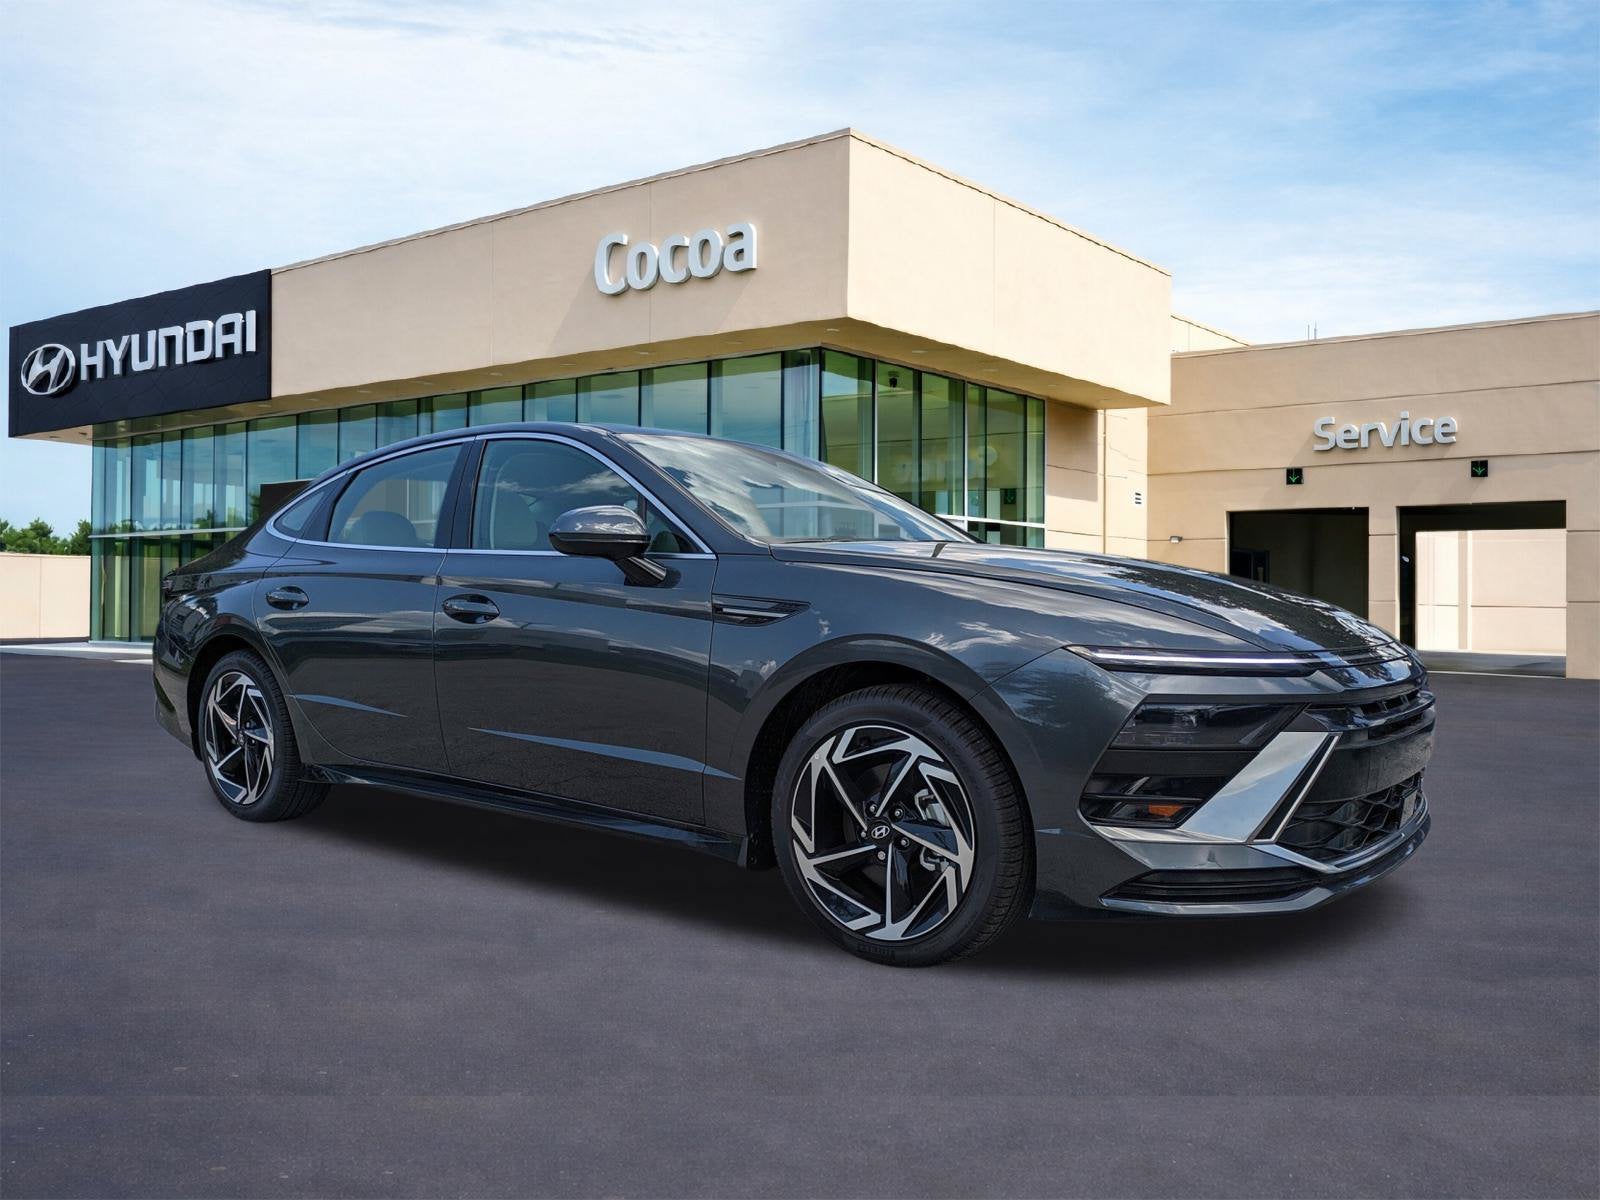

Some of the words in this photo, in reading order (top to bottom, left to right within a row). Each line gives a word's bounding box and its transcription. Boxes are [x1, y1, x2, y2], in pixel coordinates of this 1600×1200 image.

[594, 222, 758, 295] Cocoa
[80, 310, 257, 381] HYUNDAI
[1313, 410, 1459, 451] Service
